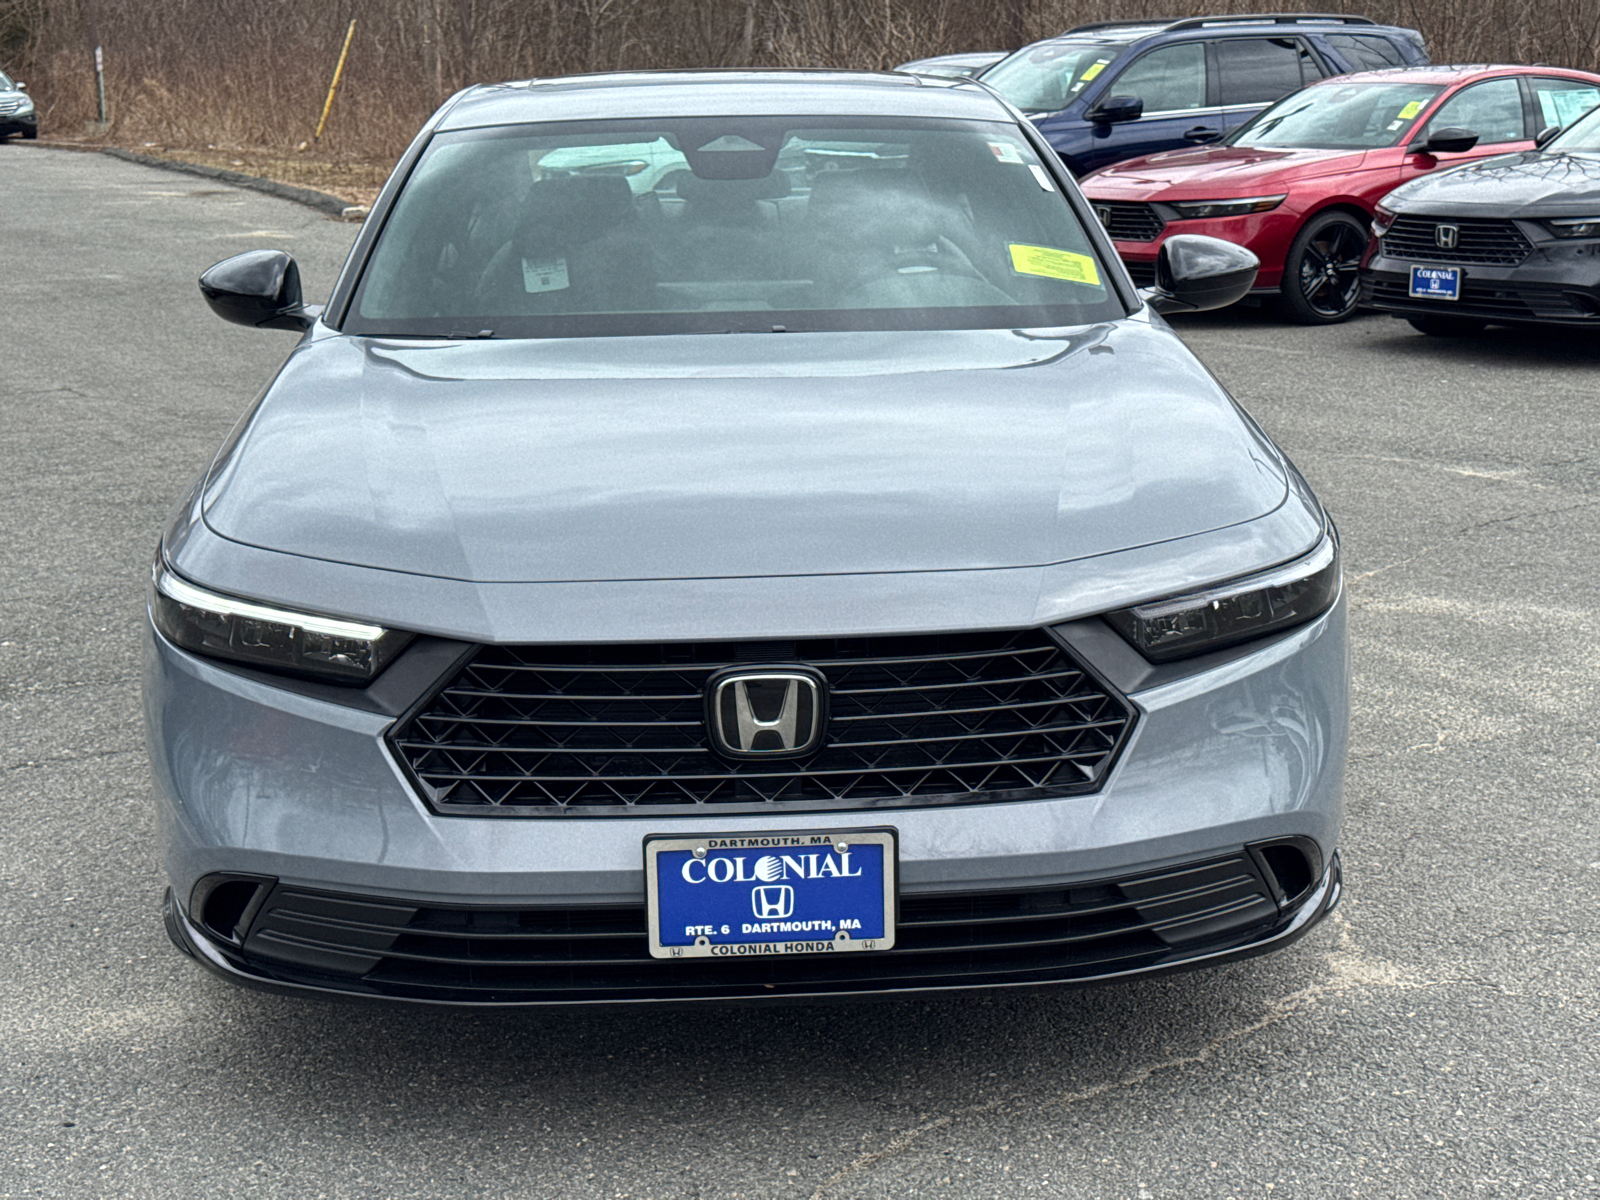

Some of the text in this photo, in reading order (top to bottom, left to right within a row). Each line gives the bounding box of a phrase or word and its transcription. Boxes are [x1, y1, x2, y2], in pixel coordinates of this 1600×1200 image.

[708, 836, 831, 848] DARTMOUTH, MA
[681, 852, 862, 884] COLONIAL
[685, 919, 861, 936] RTE. 6 DARTMOUTH, MA
[711, 941, 835, 956] COLONIAL HONDA
